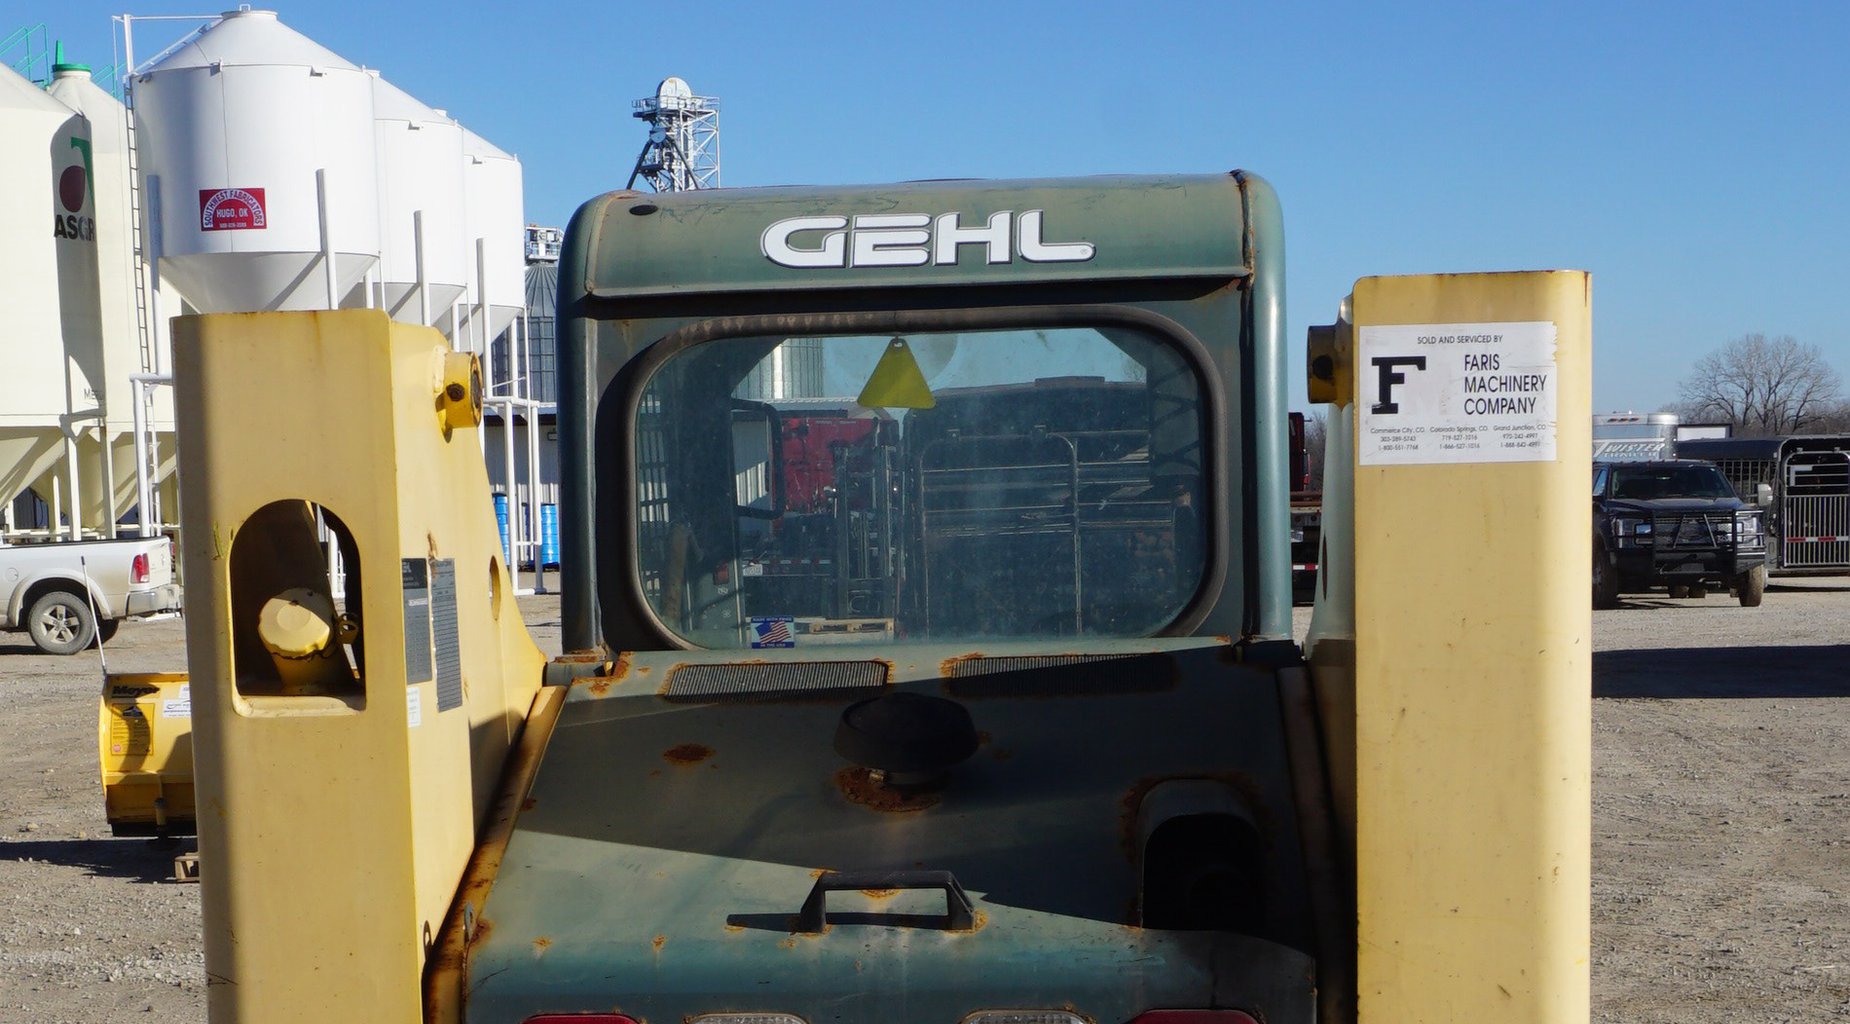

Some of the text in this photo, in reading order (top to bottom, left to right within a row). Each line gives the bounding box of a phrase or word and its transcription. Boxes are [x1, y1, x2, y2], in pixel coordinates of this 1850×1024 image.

[760, 210, 1097, 268] GEHL
[1417, 335, 1503, 345] SOLD AND SERVICED BY
[1464, 354, 1500, 371] FARIS
[1464, 375, 1547, 393] MACHINERY
[1464, 397, 1537, 415] COMPANY
[1593, 439, 1666, 457] TWISTER
